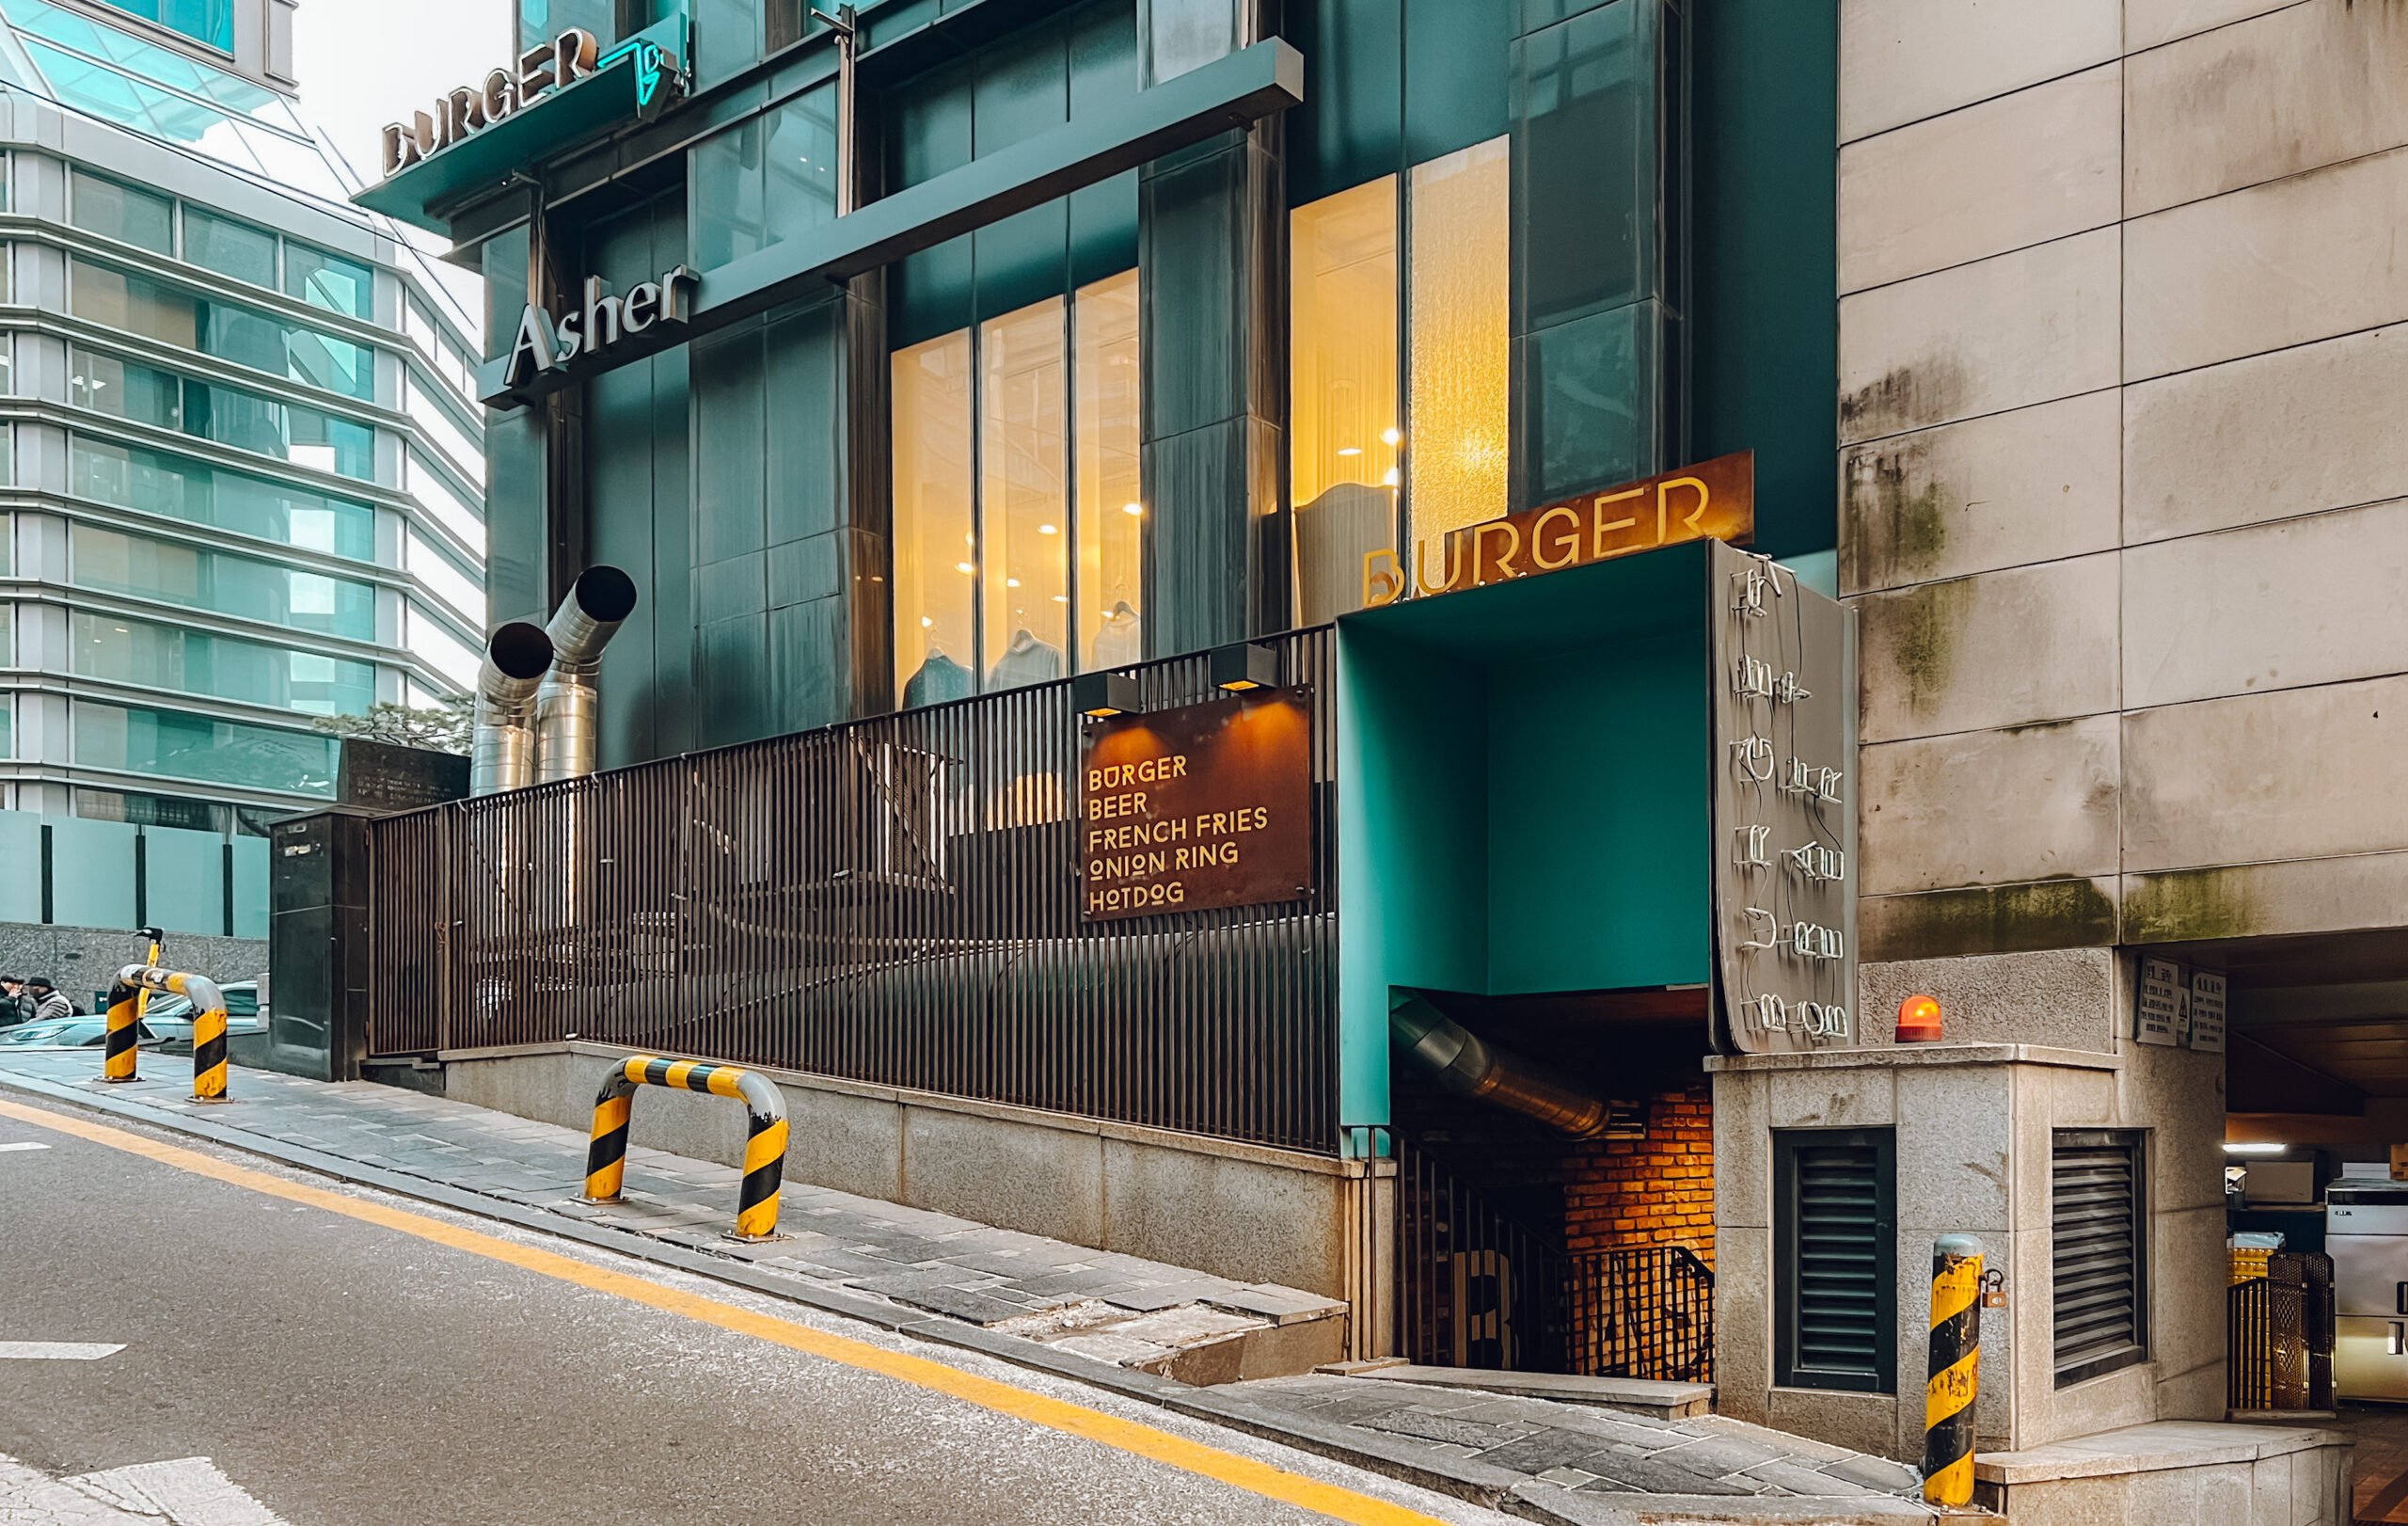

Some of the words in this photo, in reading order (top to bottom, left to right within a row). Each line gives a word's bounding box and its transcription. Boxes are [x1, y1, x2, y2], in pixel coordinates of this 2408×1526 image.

[503, 262, 701, 387] Asher
[1363, 476, 1710, 609] BURGER
[1089, 755, 1187, 791] BURGER
[1089, 792, 1148, 820] BEER
[1089, 819, 1187, 850] FRENCH
[1196, 806, 1269, 838] FRIES
[1089, 850, 1165, 882] ONION
[1175, 841, 1239, 871] RING
[1088, 881, 1185, 913] HOTDOG
